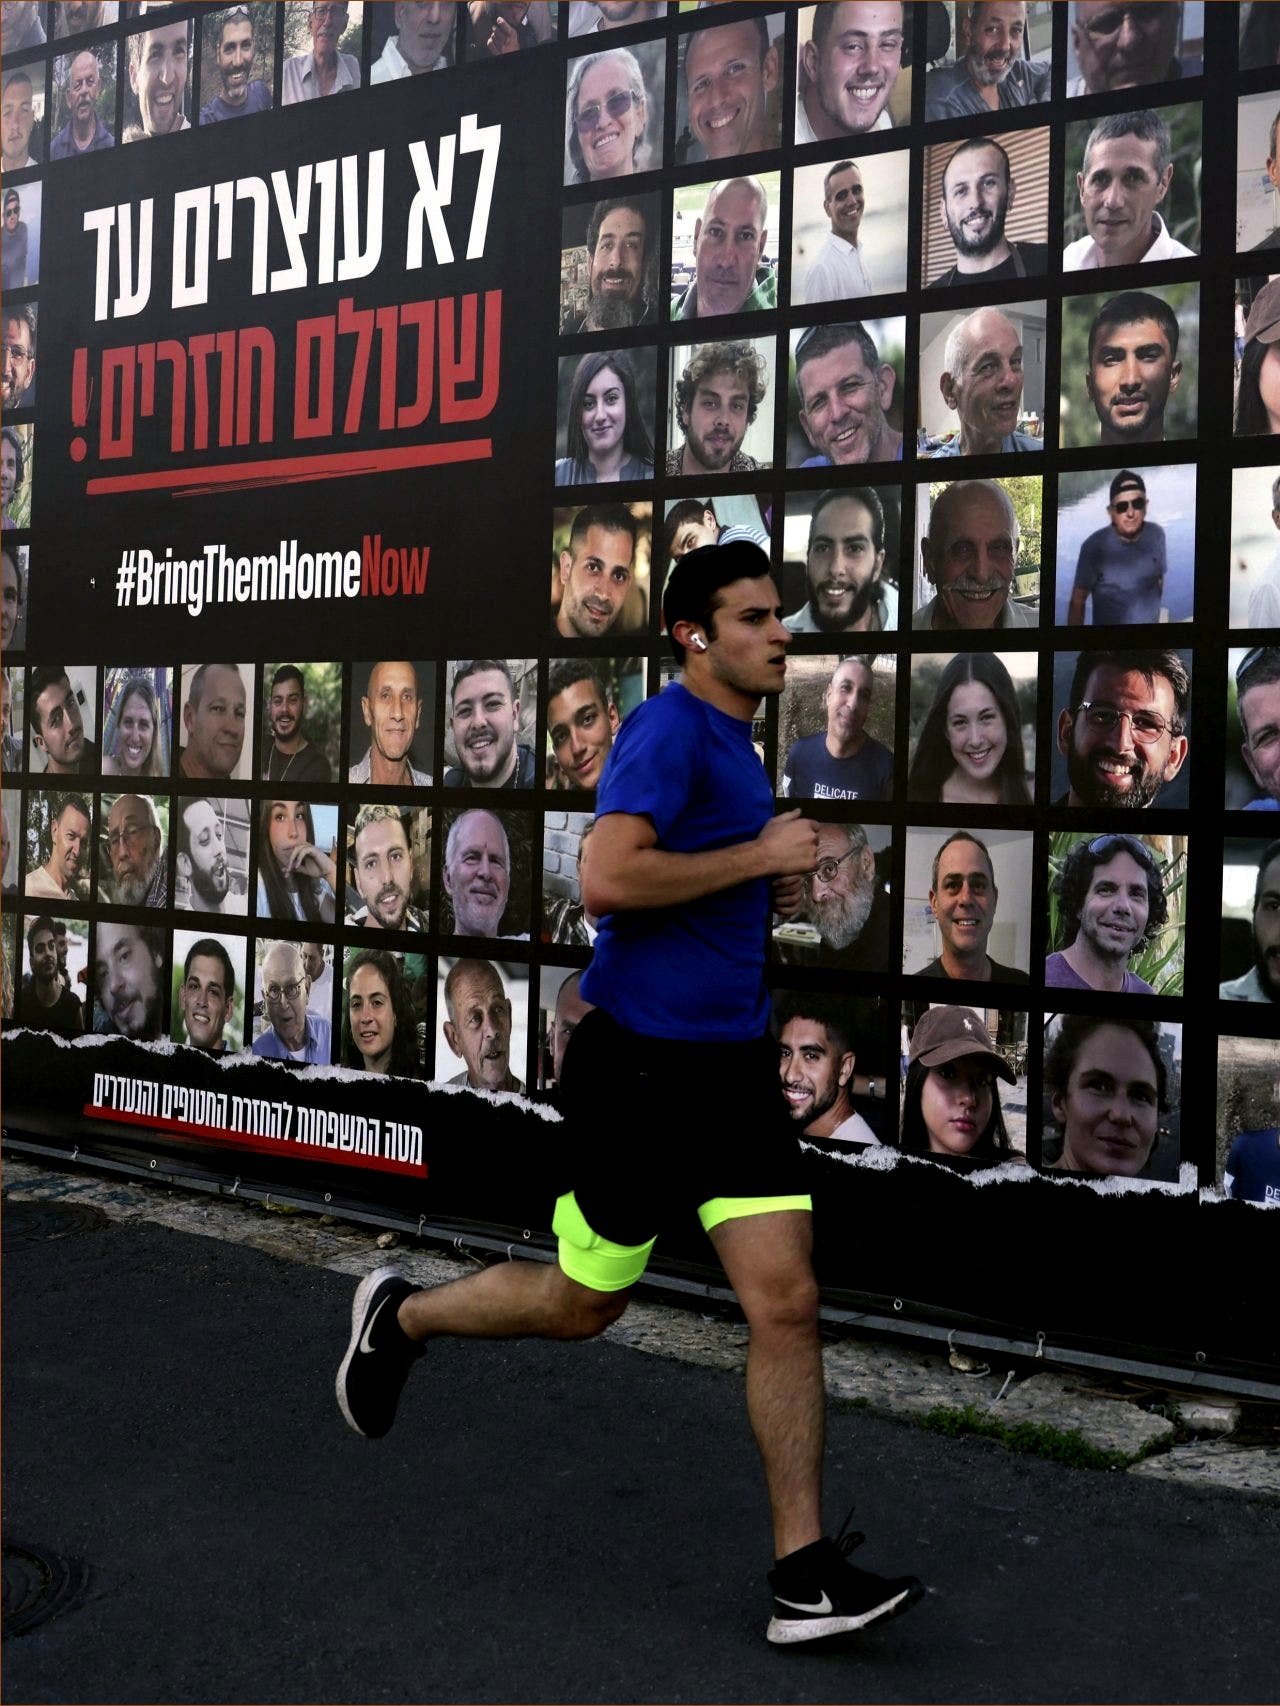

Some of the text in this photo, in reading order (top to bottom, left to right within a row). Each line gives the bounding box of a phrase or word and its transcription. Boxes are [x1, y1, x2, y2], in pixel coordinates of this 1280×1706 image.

[83, 113, 501, 321] לא עוצרים עד
[69, 289, 502, 462] שכולם חוזרים!
[115, 534, 431, 616] #BringThemHomeNow
[93, 1073, 423, 1165] מטה המשפחות להחזרת החטופים והנעדרים
